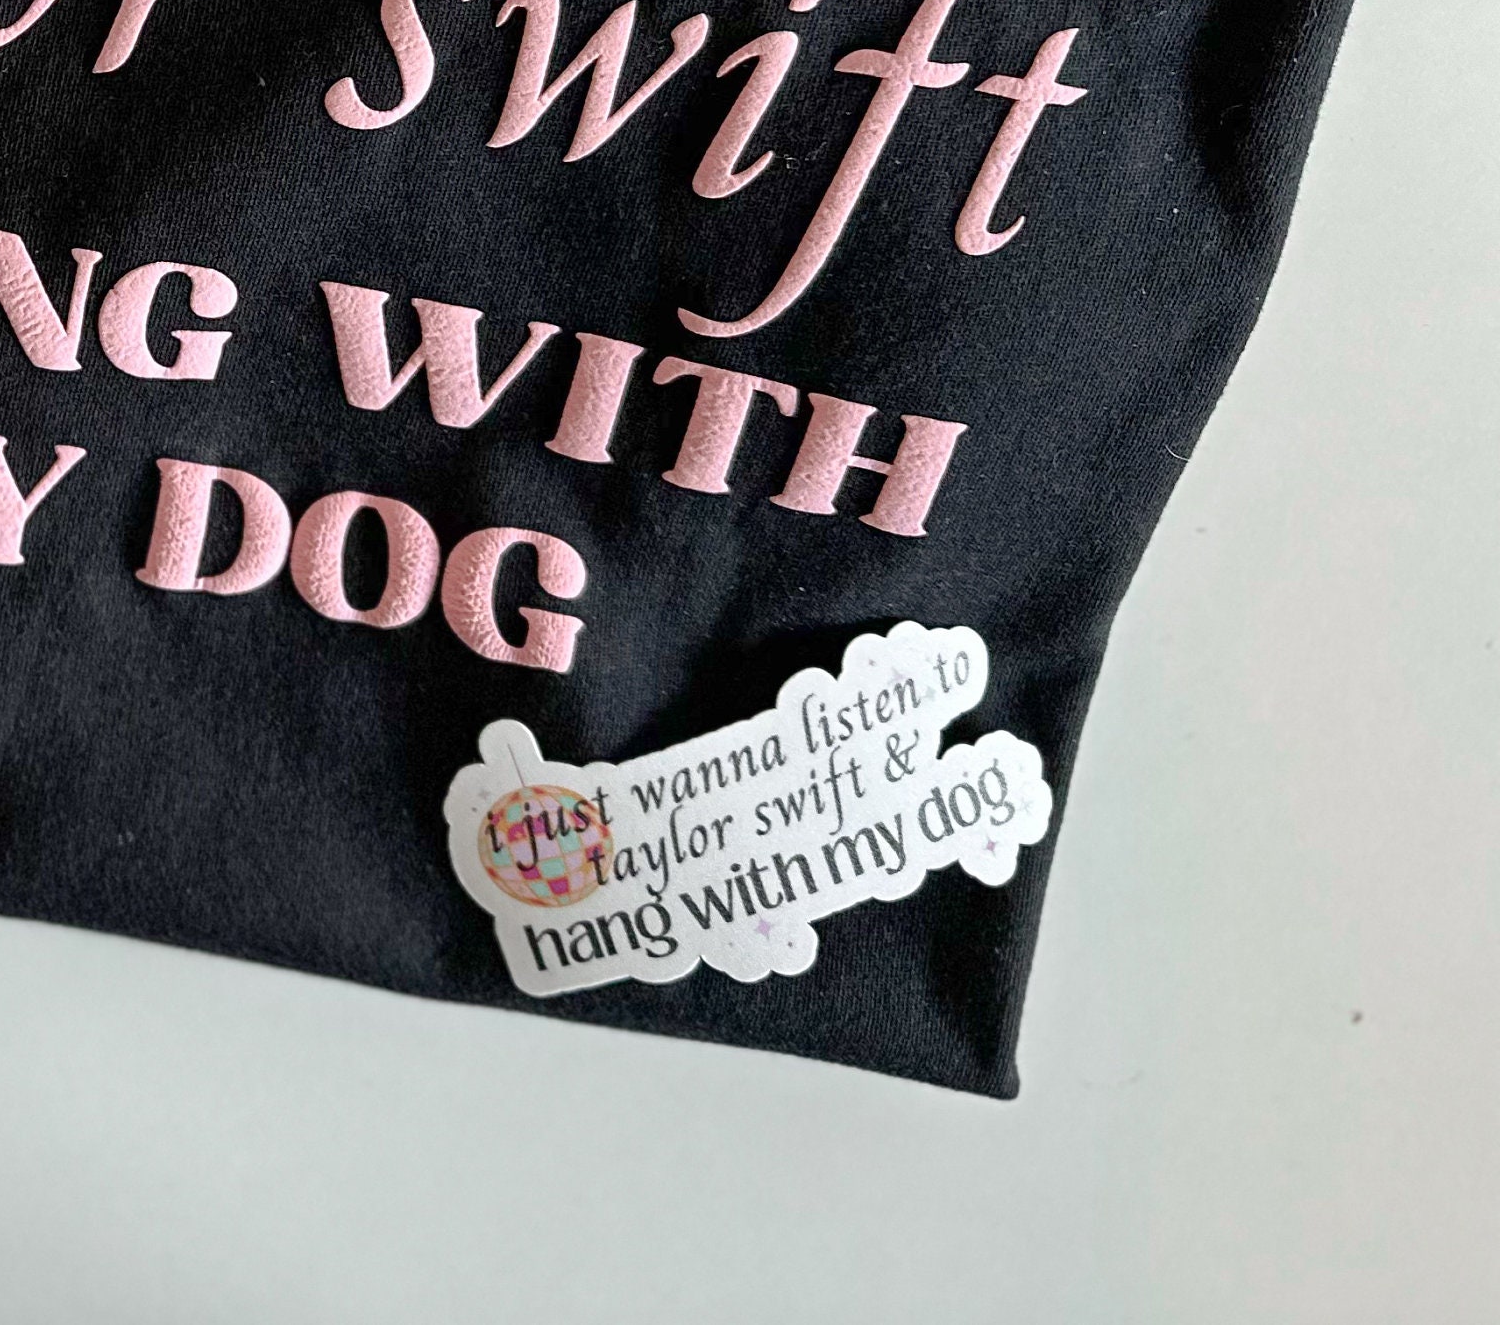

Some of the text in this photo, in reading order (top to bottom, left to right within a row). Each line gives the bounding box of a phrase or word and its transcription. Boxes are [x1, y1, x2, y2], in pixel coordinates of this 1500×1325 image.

[319, 281, 969, 537] WITH
[135, 457, 588, 674] DOG
[484, 649, 971, 870] i just wanna listen to
[523, 759, 1017, 972] hang with my dog
[590, 728, 920, 896] taylor swift &
